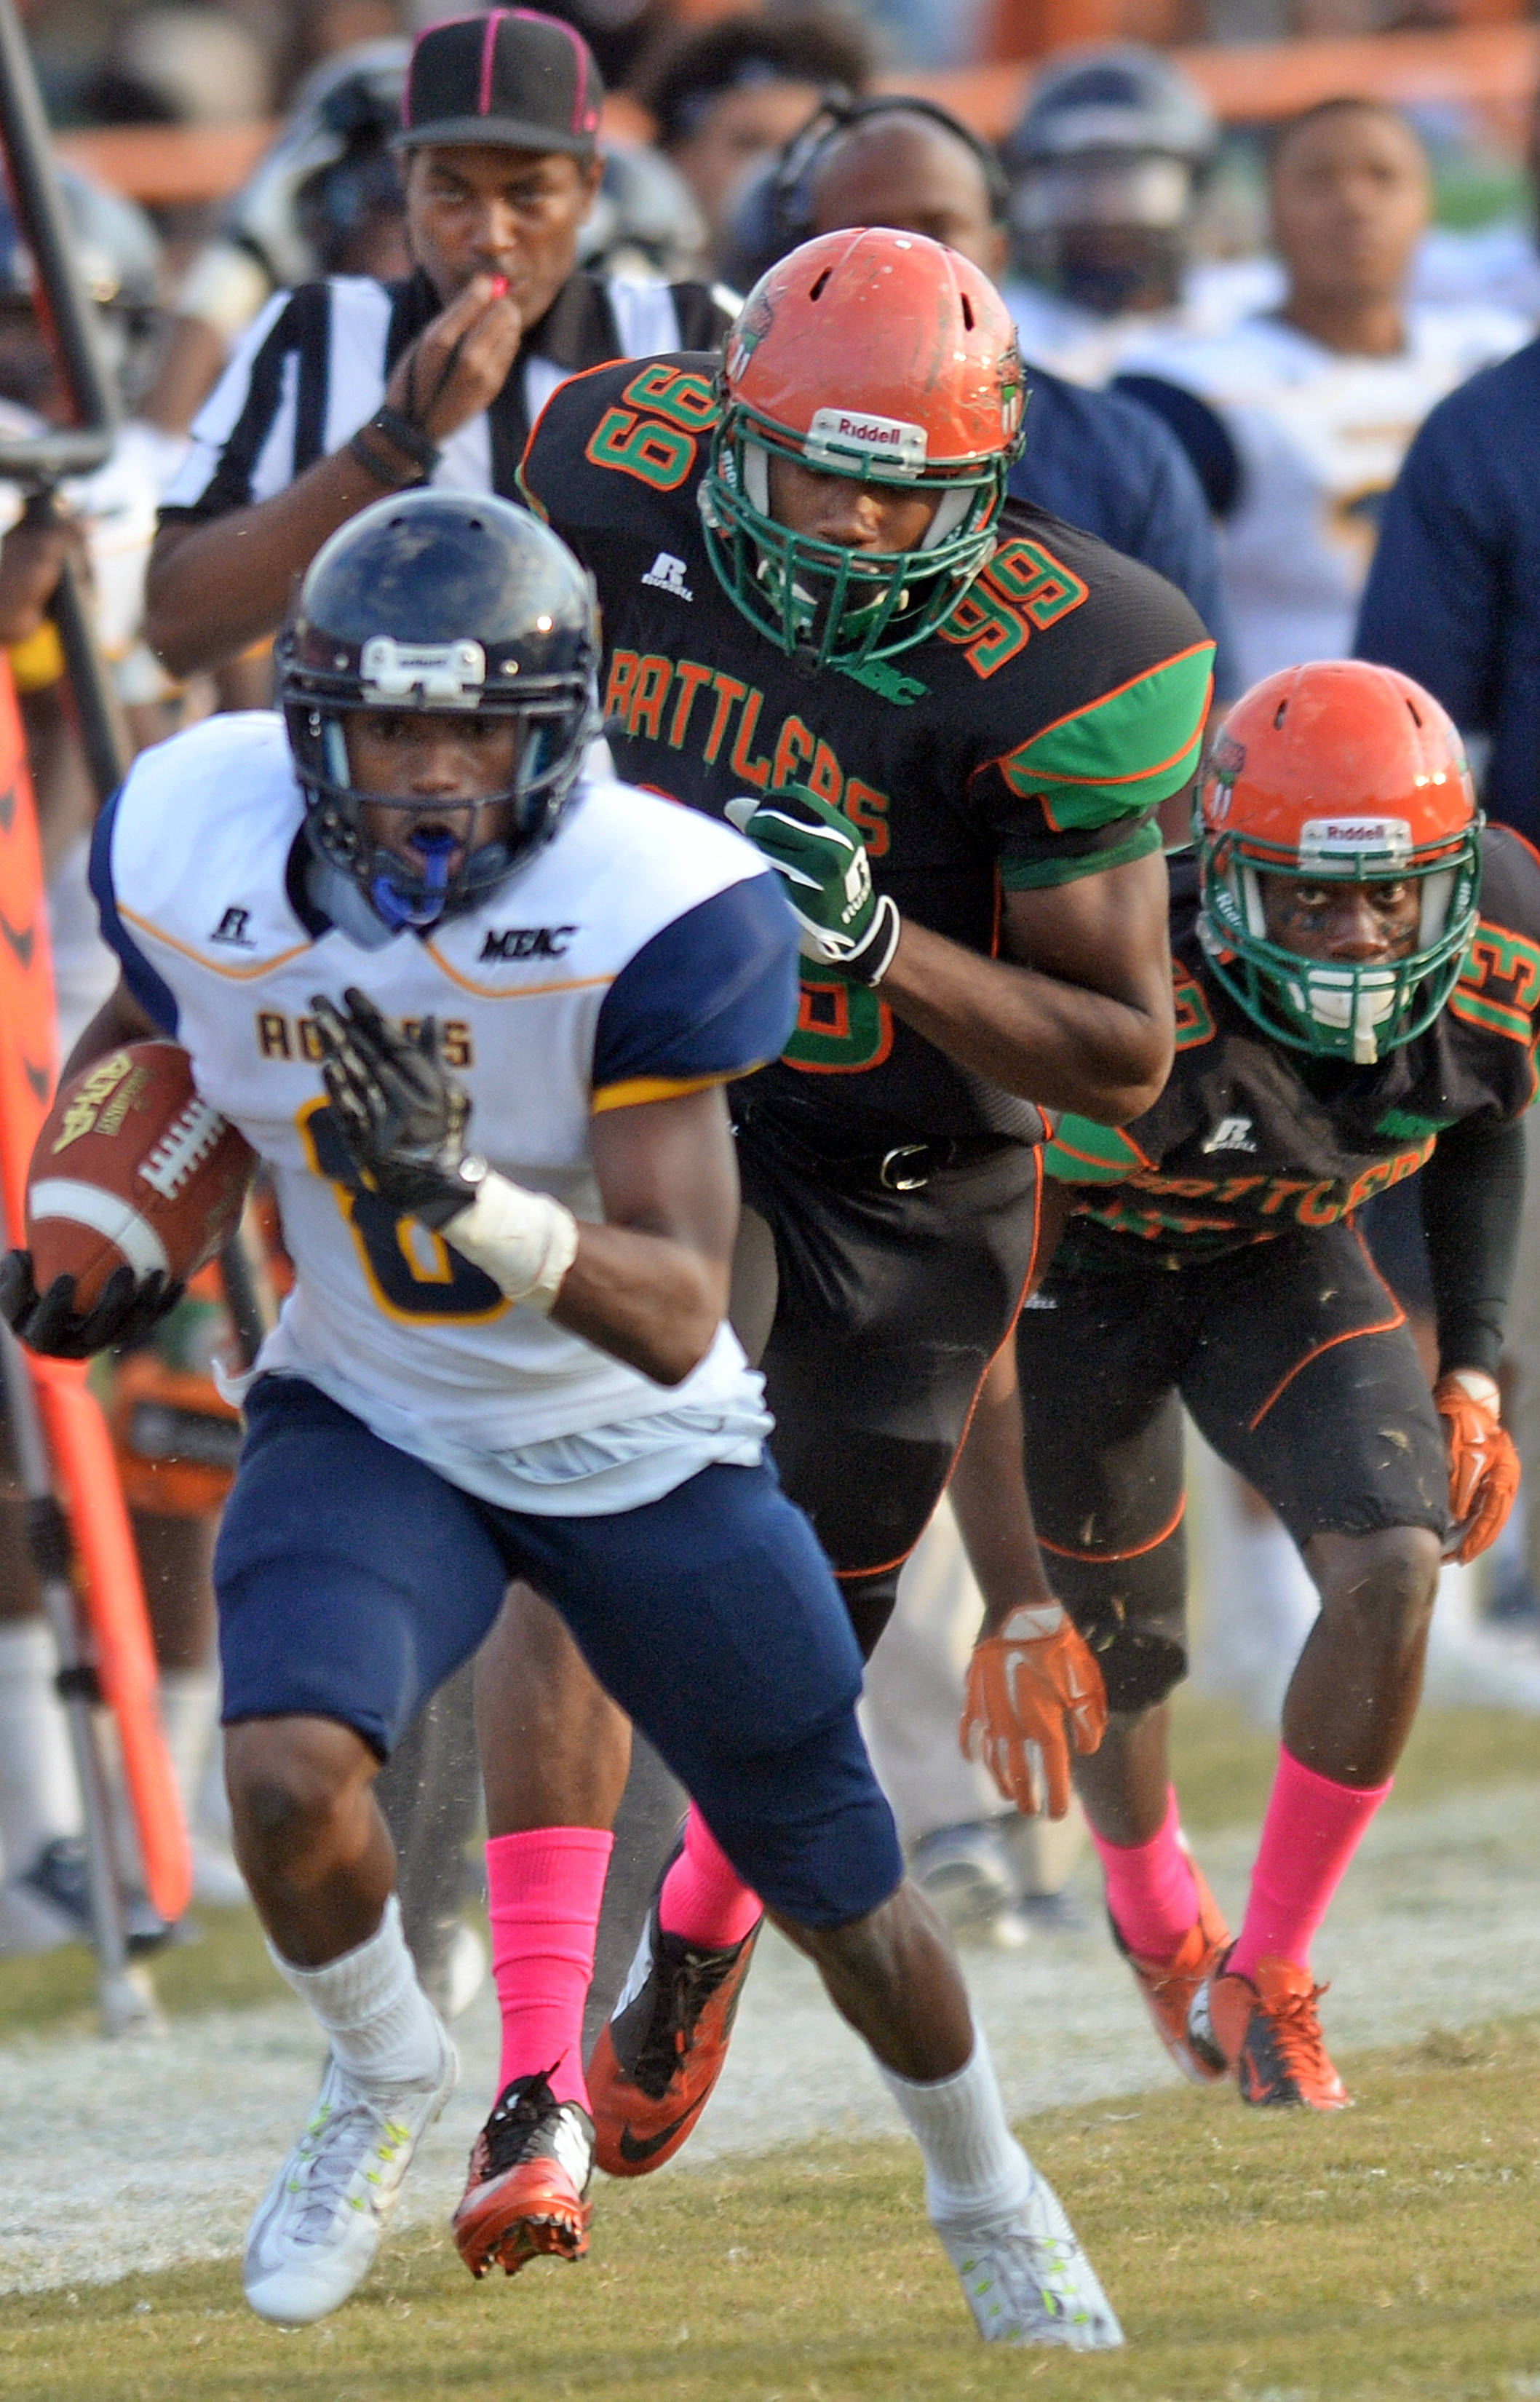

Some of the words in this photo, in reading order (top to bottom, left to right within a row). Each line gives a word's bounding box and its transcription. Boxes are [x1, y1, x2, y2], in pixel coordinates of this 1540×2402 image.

[838, 418, 902, 444] Riddell
[937, 536, 1089, 681] 99
[603, 649, 891, 857] RATTLERS
[1327, 824, 1385, 841] Riddell
[479, 926, 580, 962] MEAC
